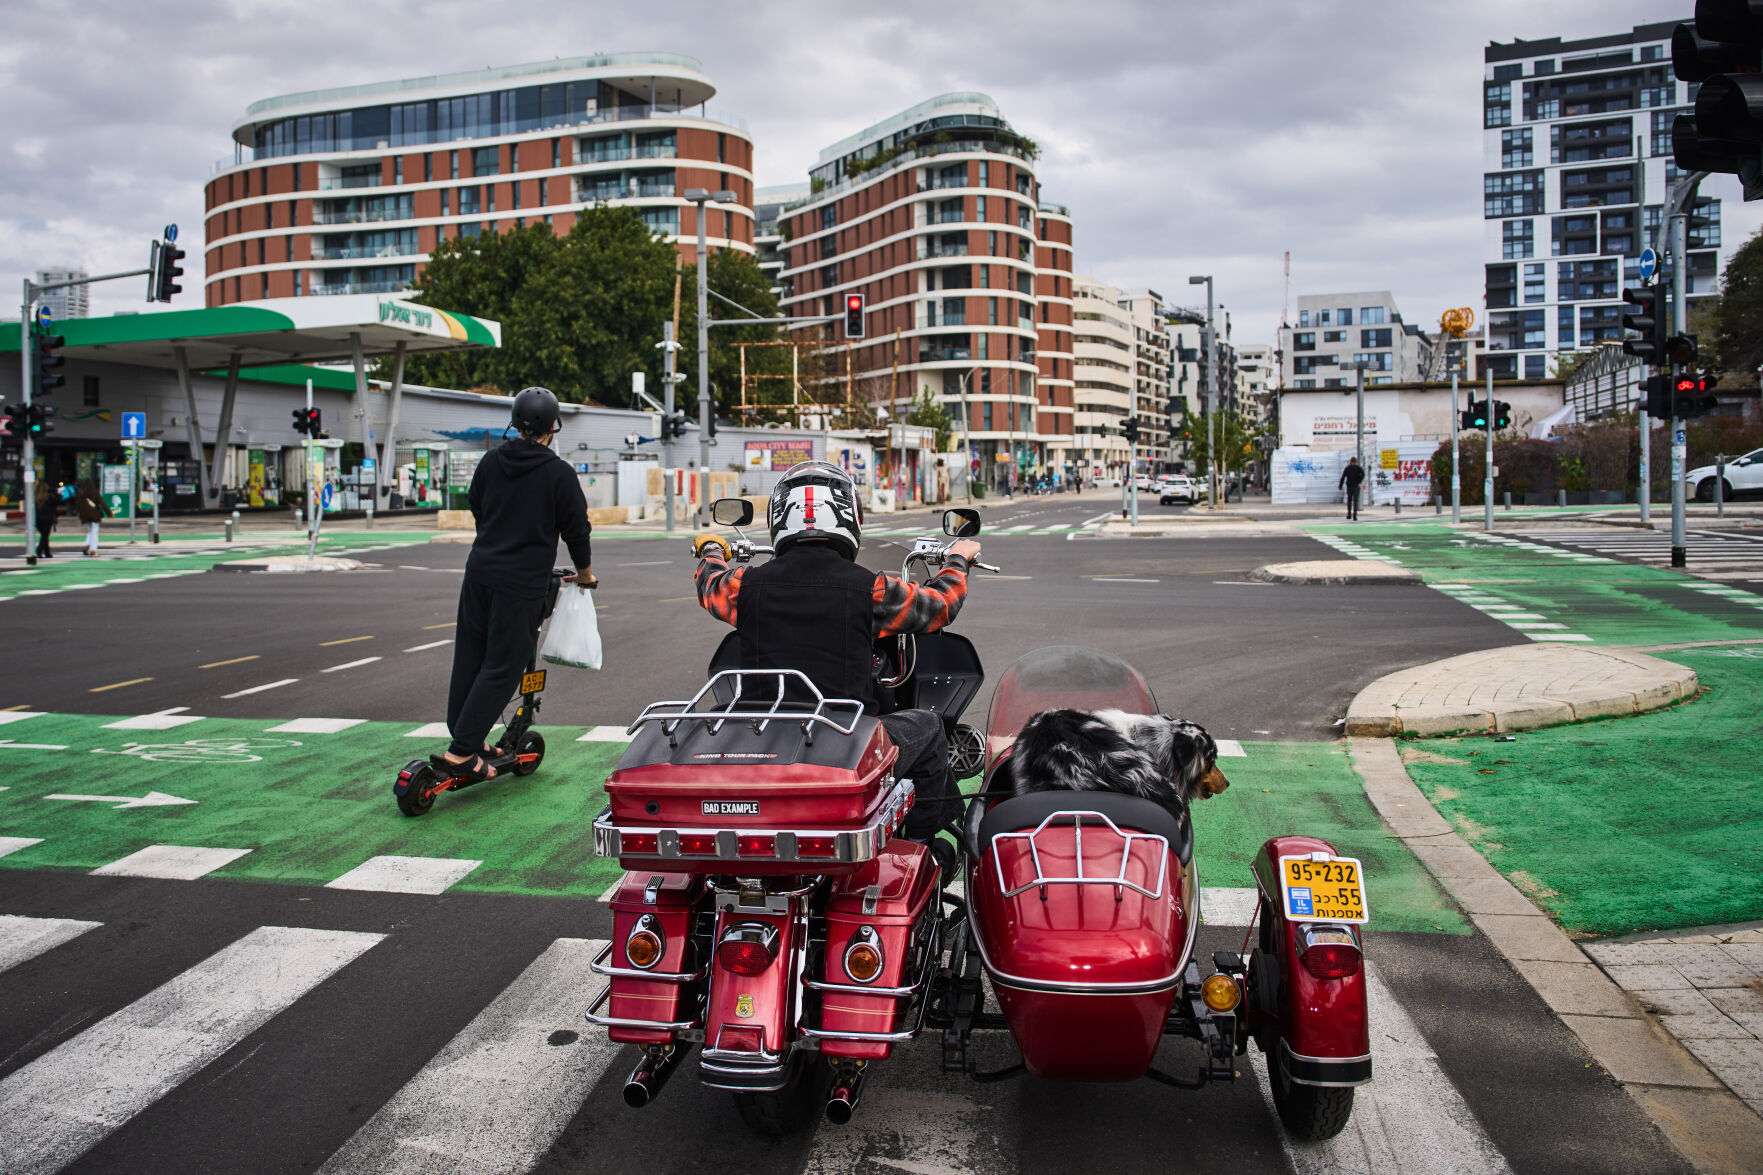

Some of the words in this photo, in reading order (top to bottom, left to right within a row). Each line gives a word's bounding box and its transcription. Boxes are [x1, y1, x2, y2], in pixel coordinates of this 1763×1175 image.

[379, 301, 410, 323] אלון
[412, 309, 432, 328] דור
[1346, 420, 1376, 429] מיאל
[747, 441, 768, 450] AQUA
[769, 441, 787, 450] CITY
[703, 803, 719, 813] BAD
[721, 803, 758, 814] EXAMPLE
[1314, 894, 1340, 904] רכב
[1338, 888, 1361, 905] 55
[1316, 908, 1363, 919] אספנות
